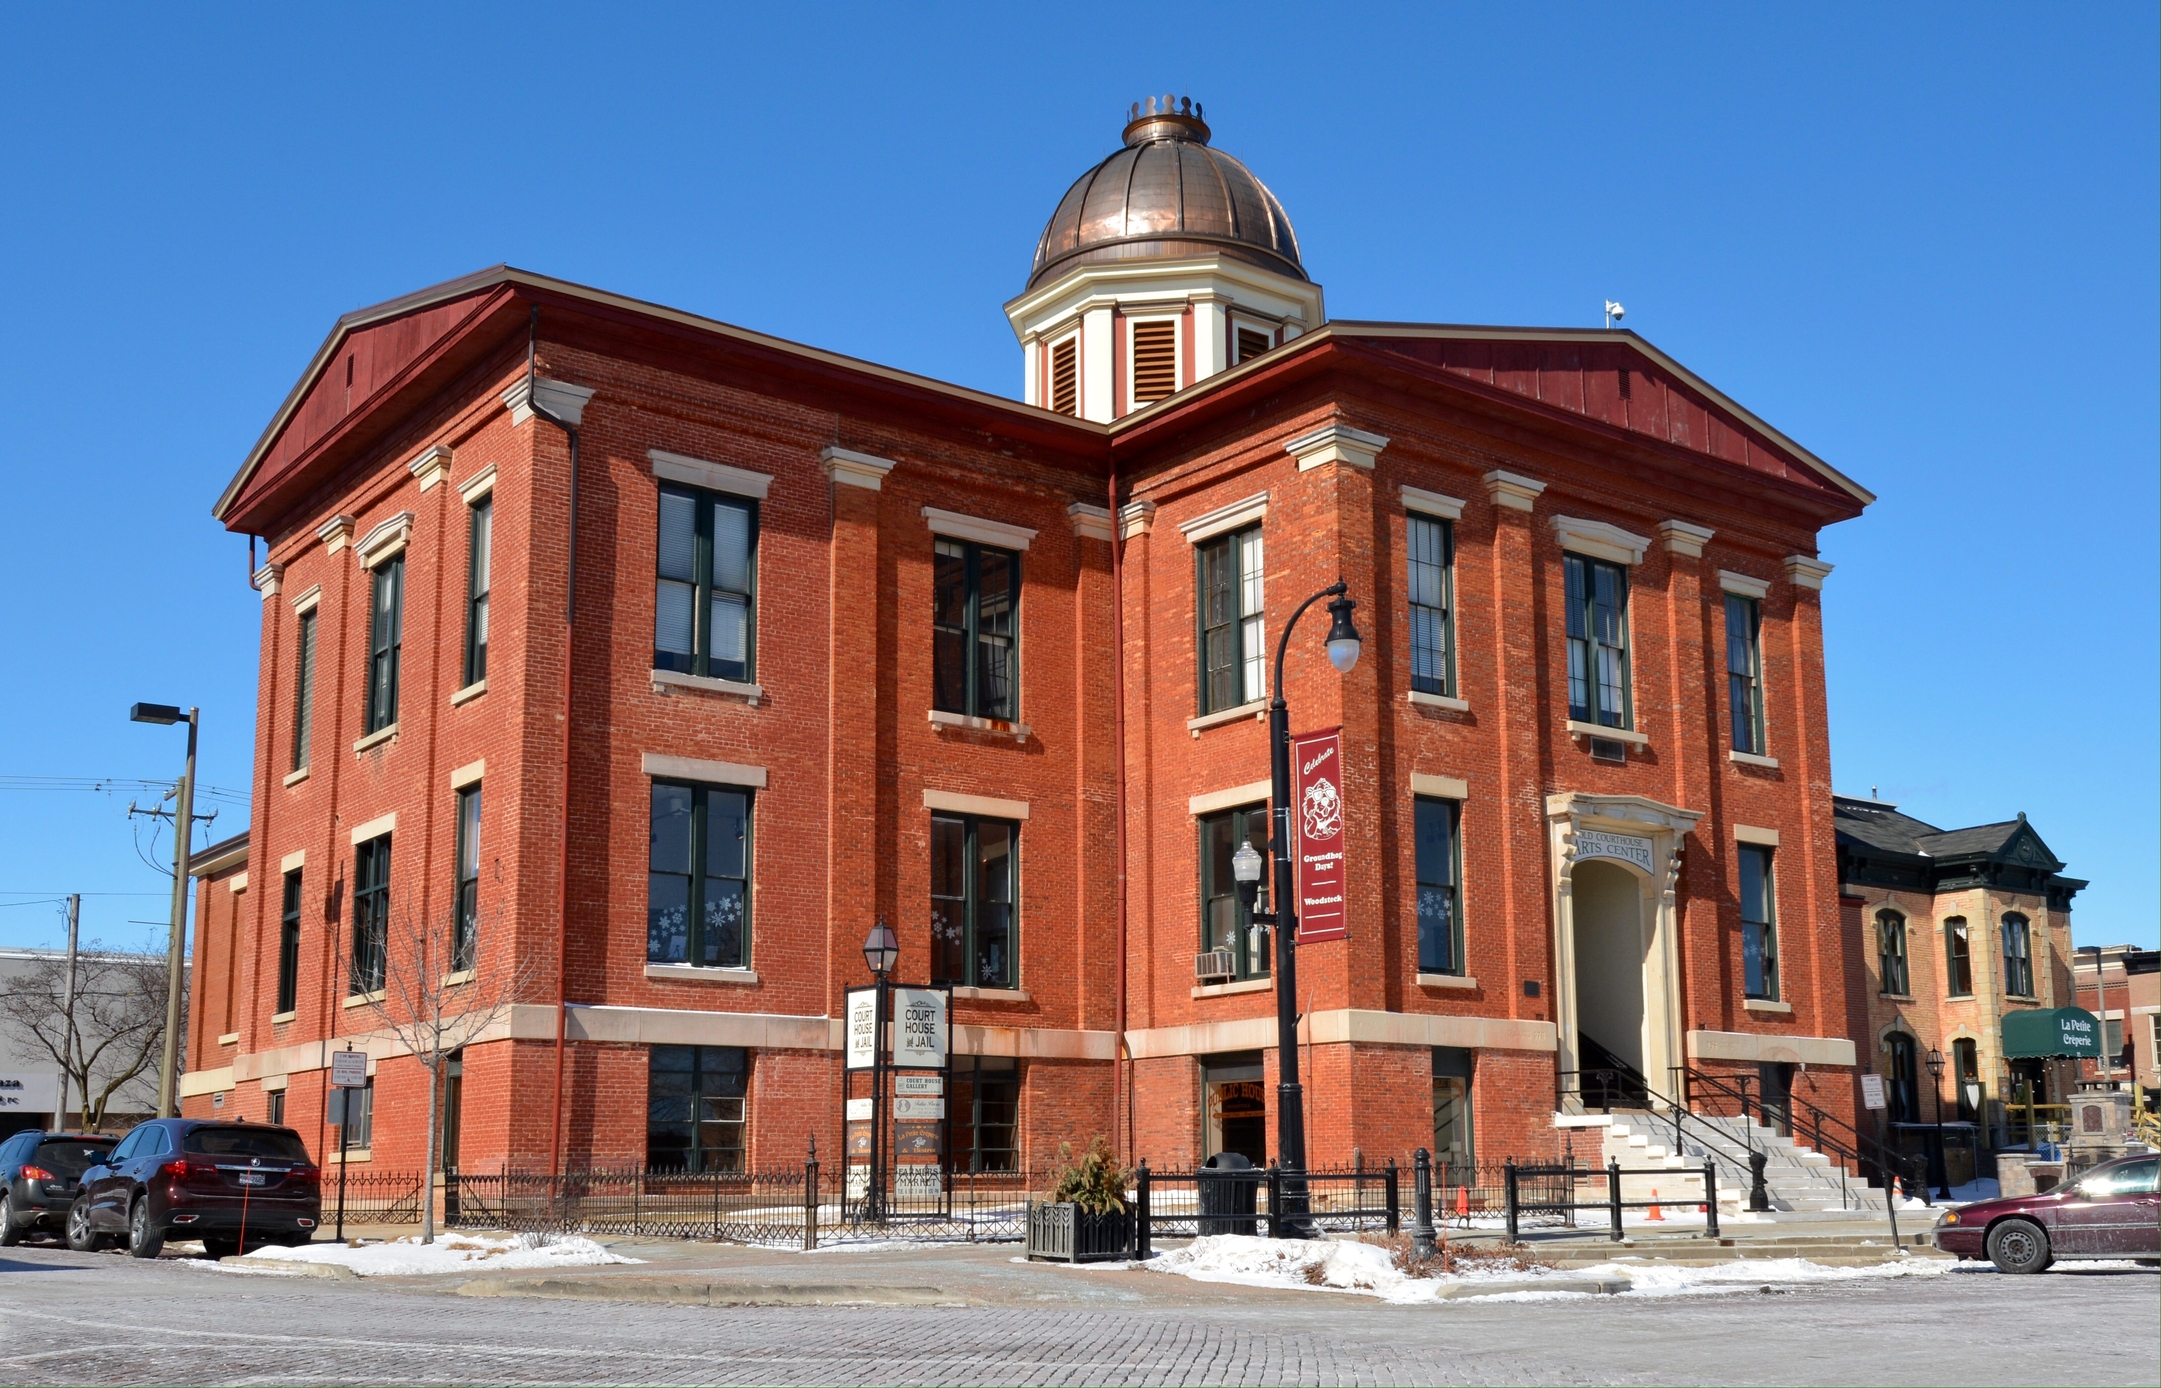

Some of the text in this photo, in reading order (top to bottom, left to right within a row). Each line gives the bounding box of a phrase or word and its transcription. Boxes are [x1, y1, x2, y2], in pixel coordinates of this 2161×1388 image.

[1304, 747, 1334, 775] Celebrate
[1579, 831, 1643, 847] OLD COURTHOUSE
[1303, 852, 1343, 863] Groundhog
[1573, 839, 1651, 867] ARTS CENTER
[1315, 861, 1334, 871] Days!
[1303, 894, 1343, 906] Woodstock
[854, 1009, 873, 1023] COURT
[905, 1009, 936, 1022] COURT
[854, 1022, 873, 1036] HOUSE
[905, 1022, 936, 1035] HOUSE
[2061, 1018, 2091, 1032] La Petite
[860, 1036, 873, 1048] JAIL
[916, 1036, 935, 1048] JAIL
[1208, 1083, 1266, 1107] PUBLIC HOUS
